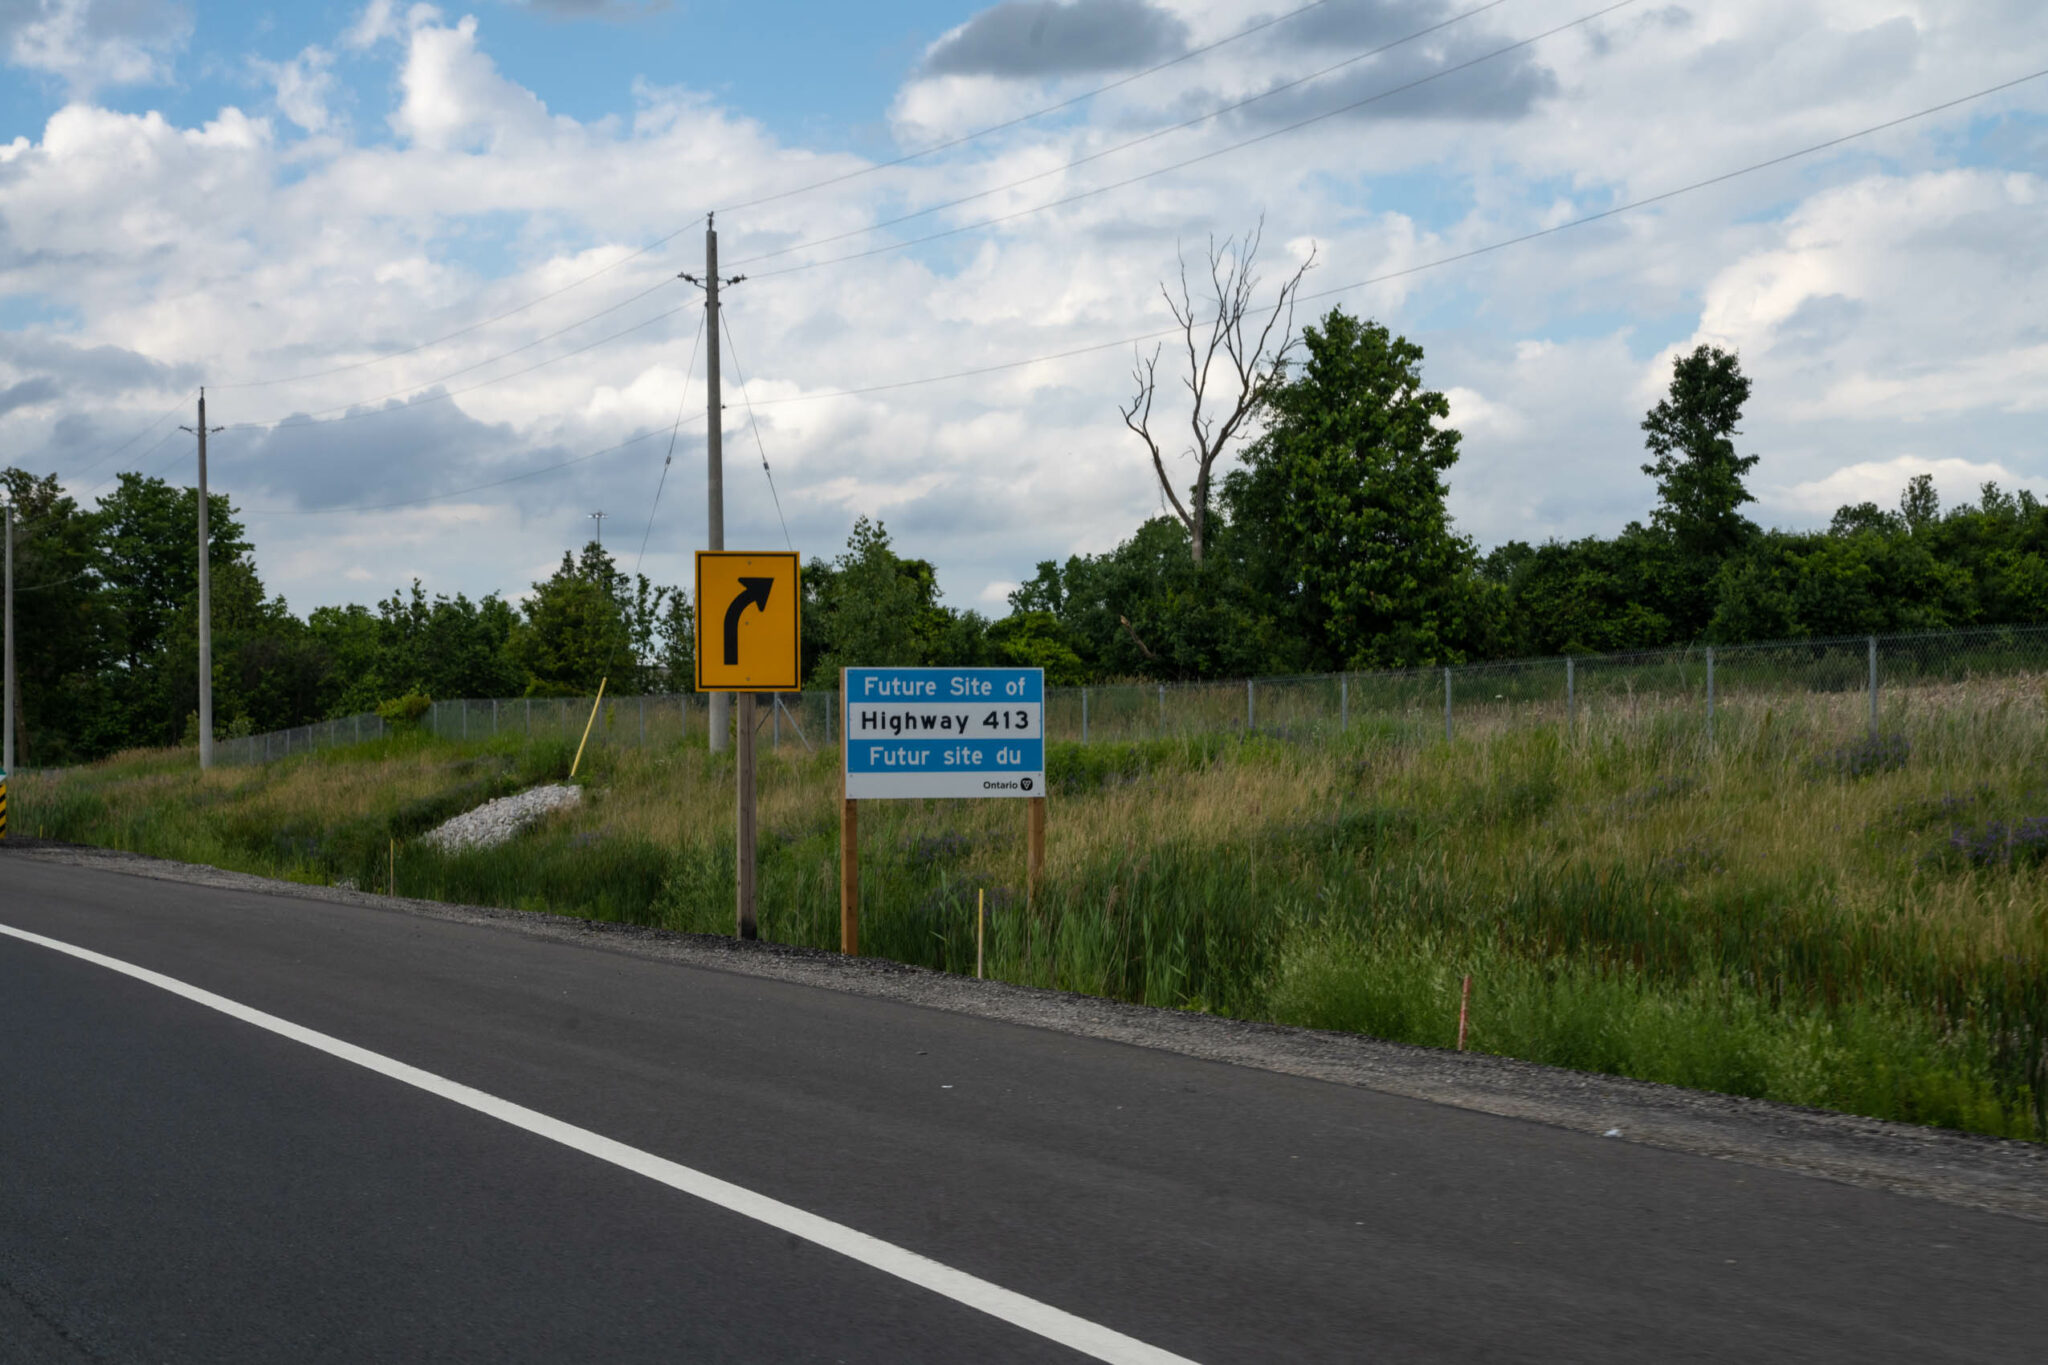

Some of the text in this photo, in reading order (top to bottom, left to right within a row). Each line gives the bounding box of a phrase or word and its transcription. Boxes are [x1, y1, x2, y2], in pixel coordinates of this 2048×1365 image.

[864, 676, 1026, 696] Future Site of
[861, 710, 1029, 736] Highway 413
[869, 746, 1021, 766] Futur site du
[983, 780, 1018, 789] Ontario
